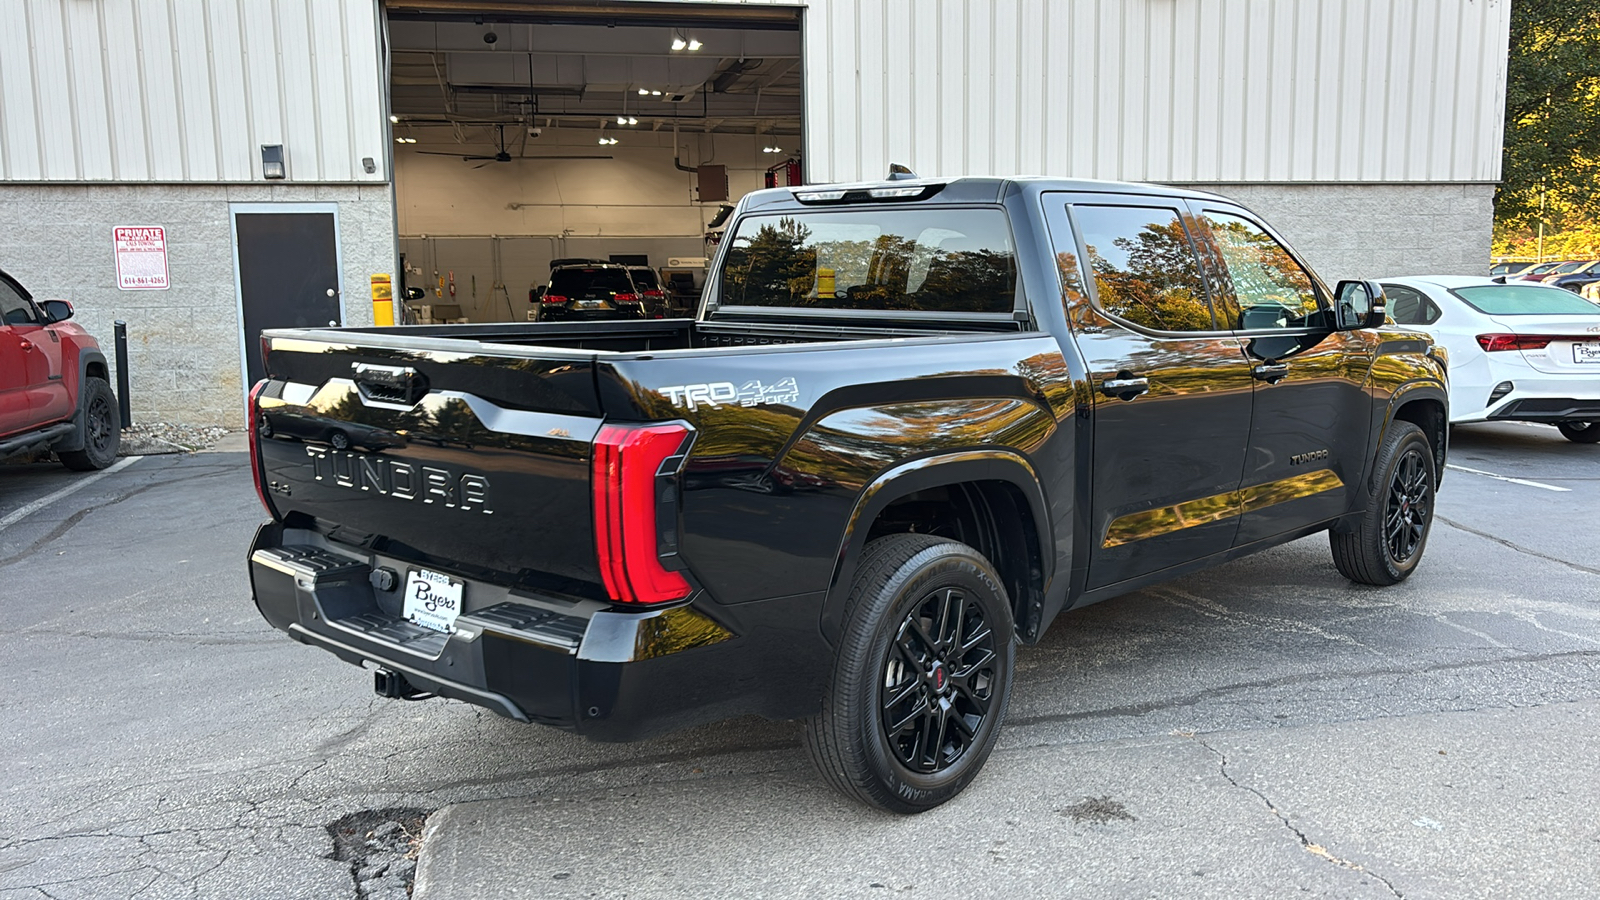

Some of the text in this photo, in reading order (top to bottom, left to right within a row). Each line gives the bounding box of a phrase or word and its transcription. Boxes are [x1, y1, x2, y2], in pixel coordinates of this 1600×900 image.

[117, 229, 162, 237] PRIVATE
[658, 381, 739, 413] TRD
[740, 393, 799, 408] SPORT
[1290, 449, 1328, 466] TUNDRA
[306, 446, 494, 515] TUNDRA
[421, 569, 450, 585] BYERS
